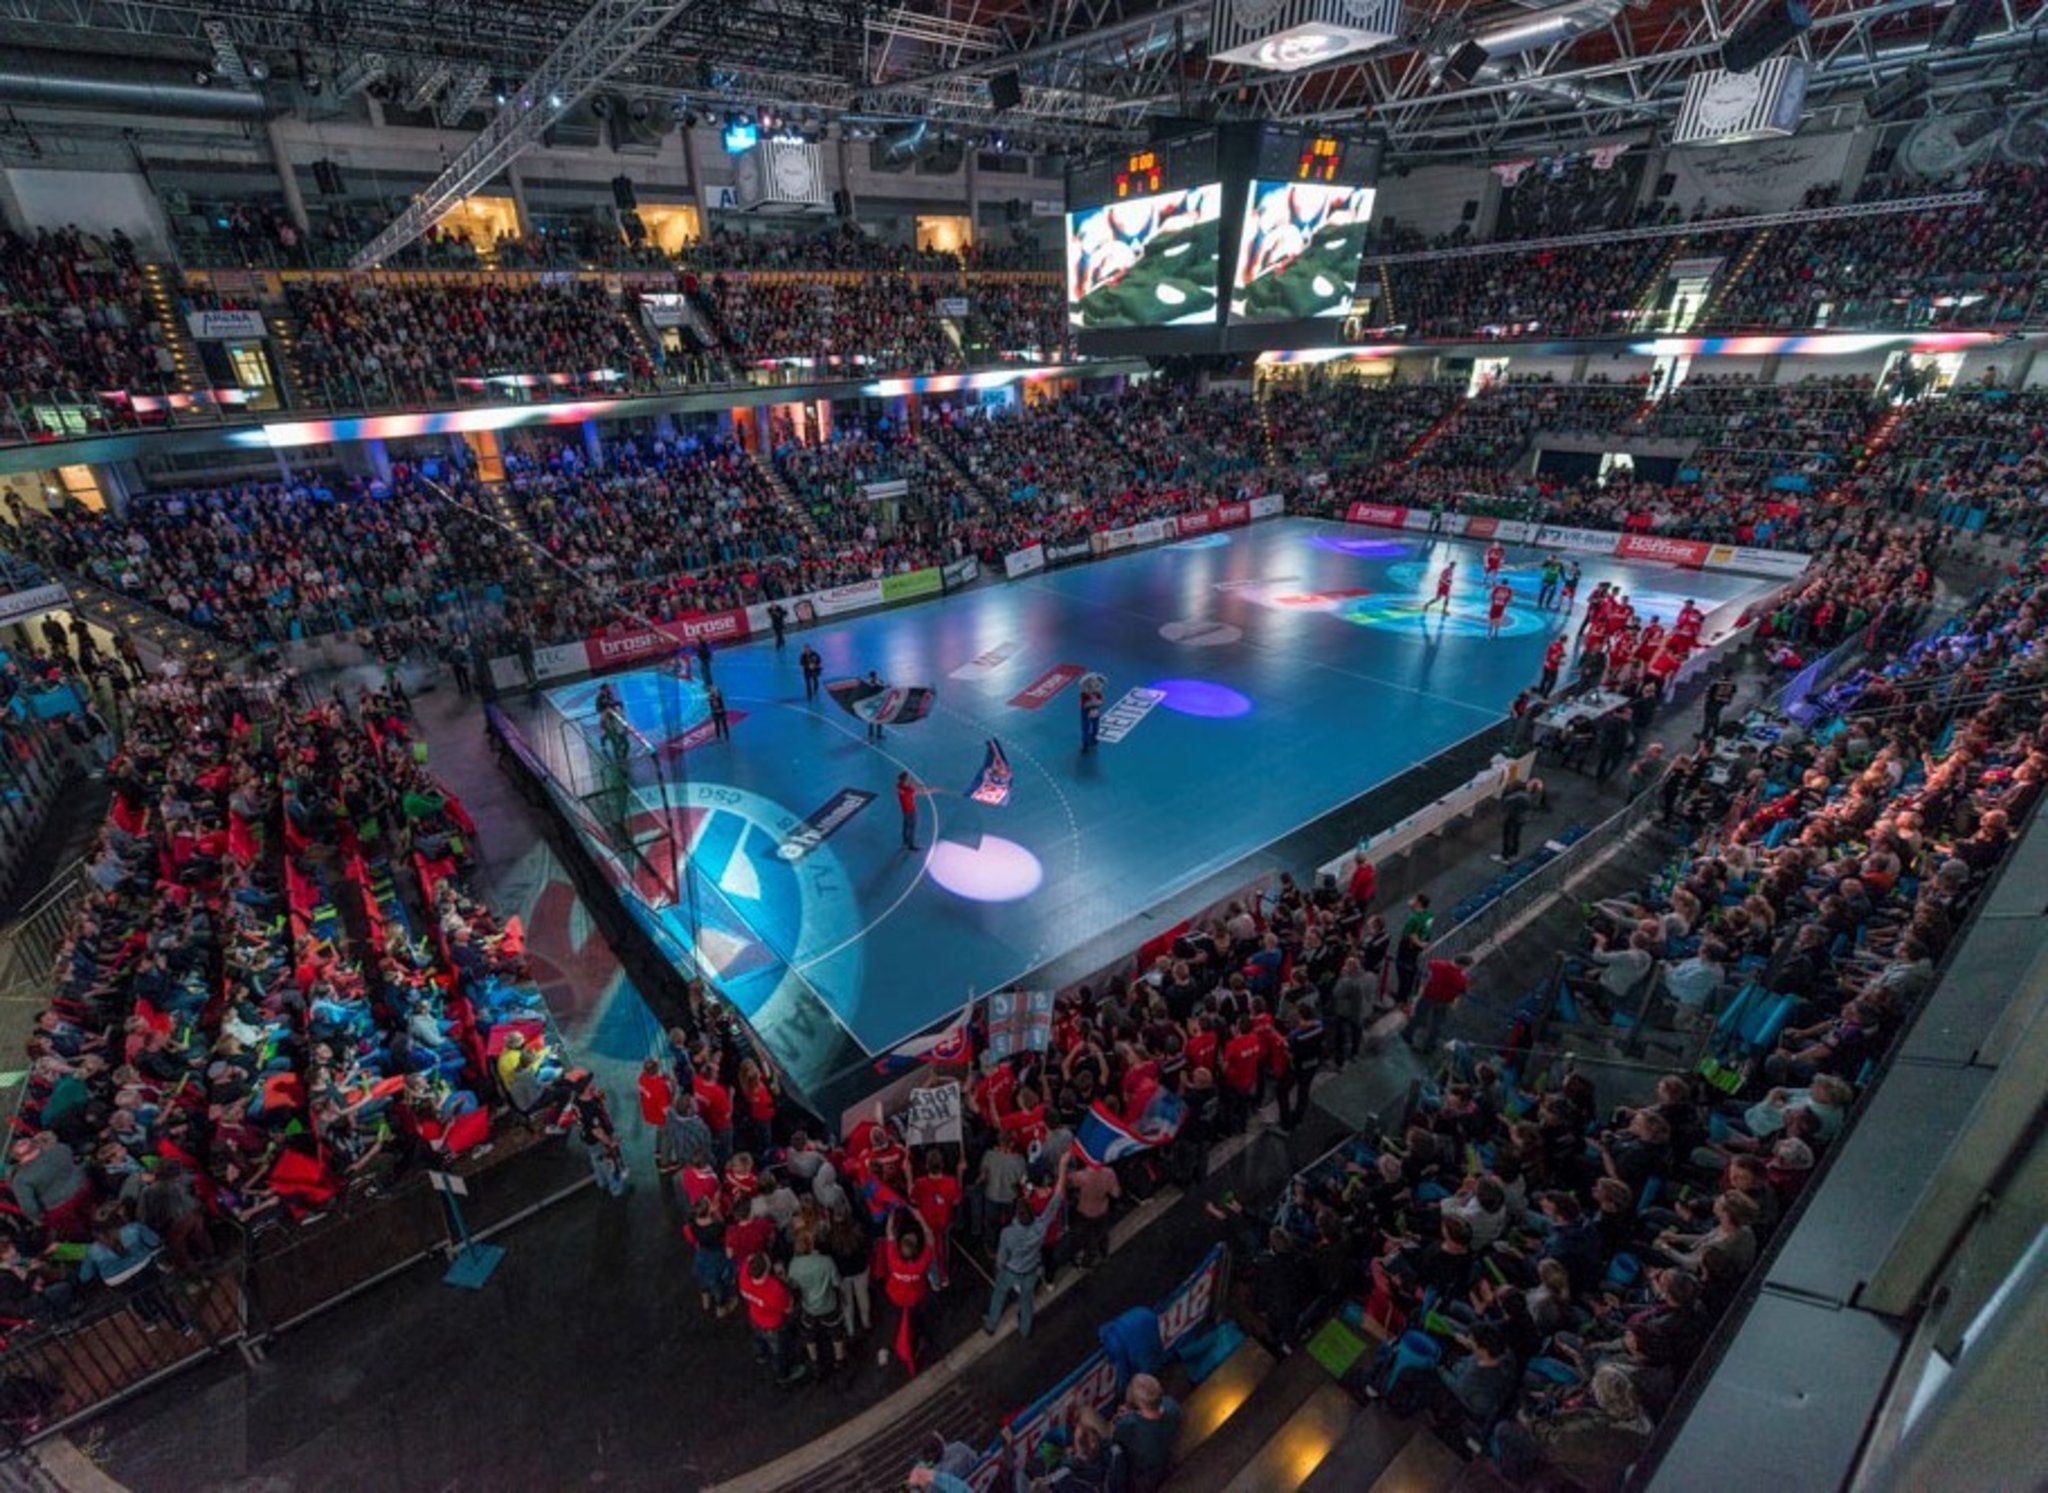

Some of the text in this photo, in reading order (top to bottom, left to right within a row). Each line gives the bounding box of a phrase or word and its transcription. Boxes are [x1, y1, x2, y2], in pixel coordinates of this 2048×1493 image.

[1627, 535, 1699, 557] Höffner
[601, 615, 737, 656] brose brose
